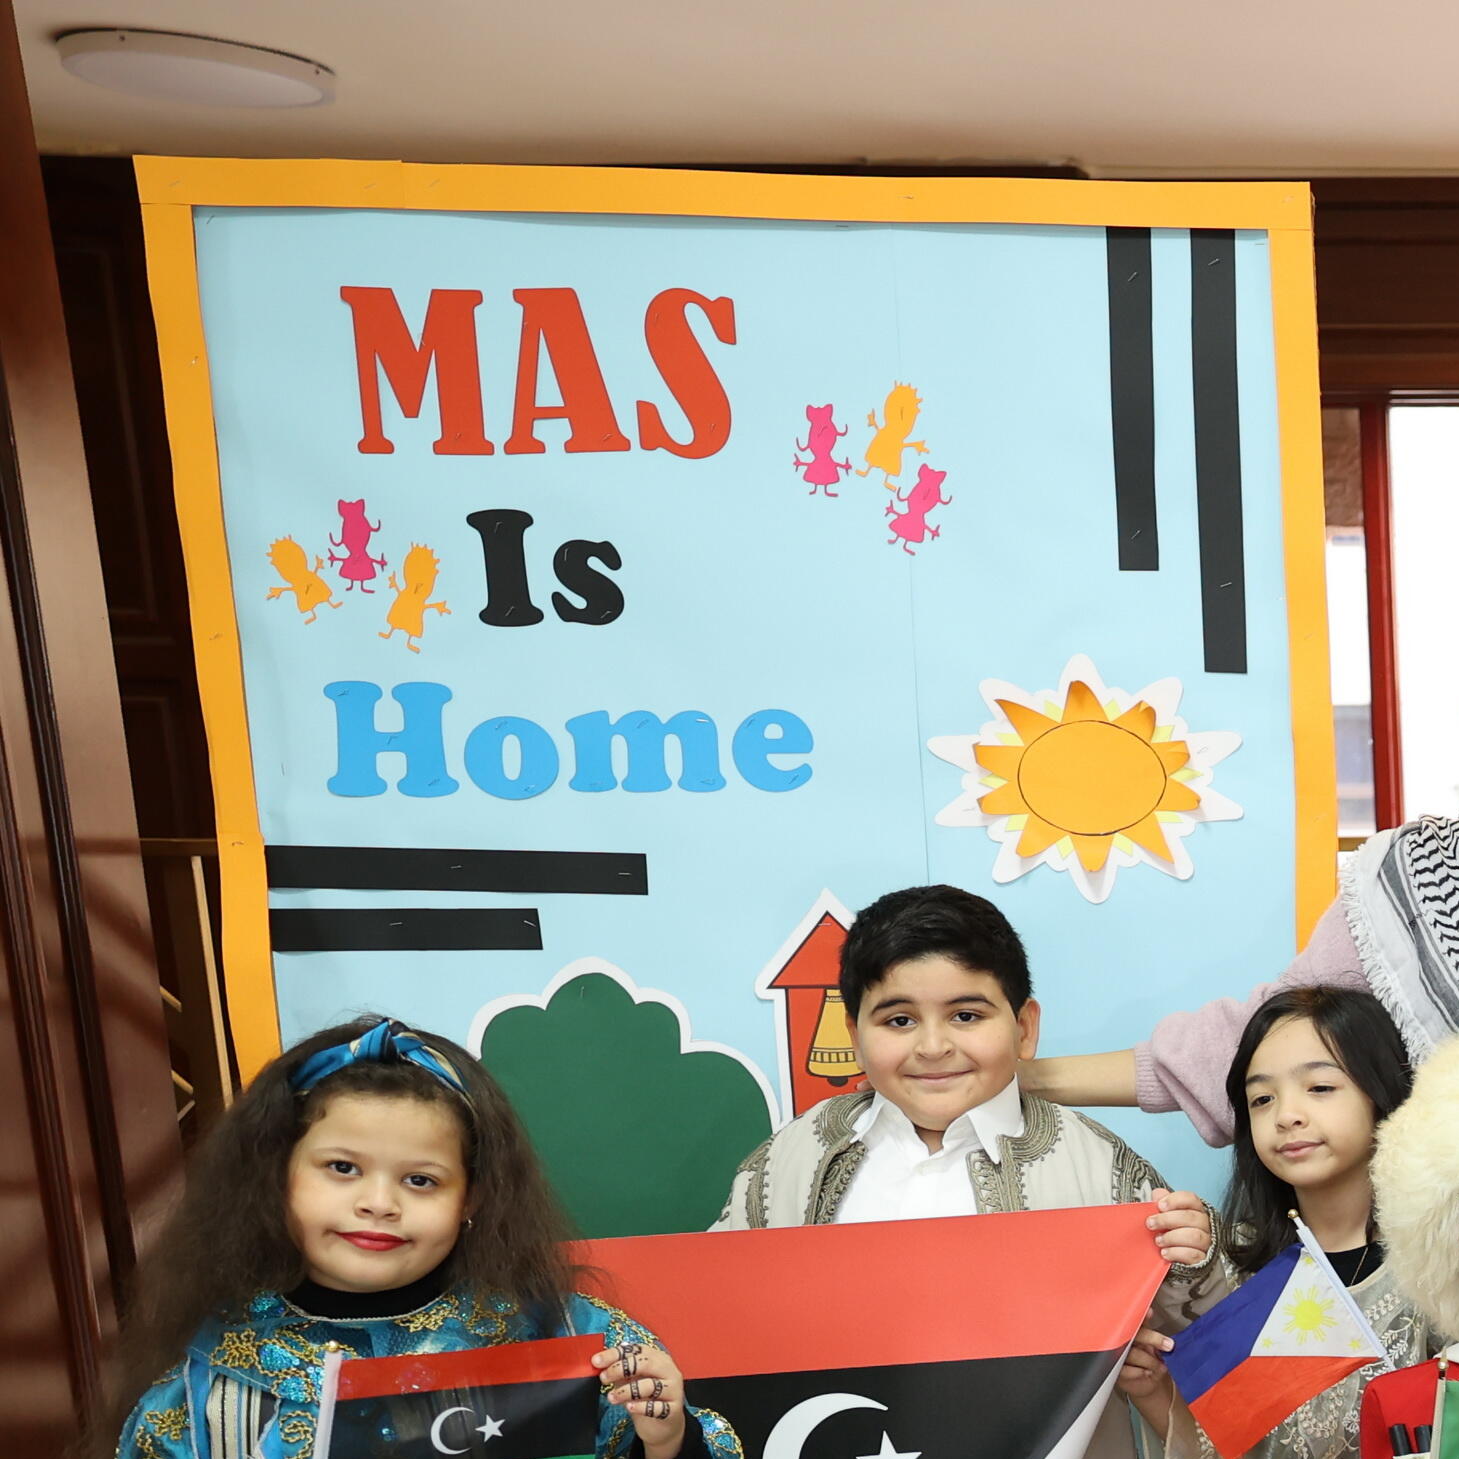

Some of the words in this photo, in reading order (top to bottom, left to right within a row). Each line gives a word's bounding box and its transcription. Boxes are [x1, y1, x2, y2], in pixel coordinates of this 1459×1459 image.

[339, 286, 737, 460] MAS
[466, 508, 625, 628] Is
[323, 679, 815, 800] Home
